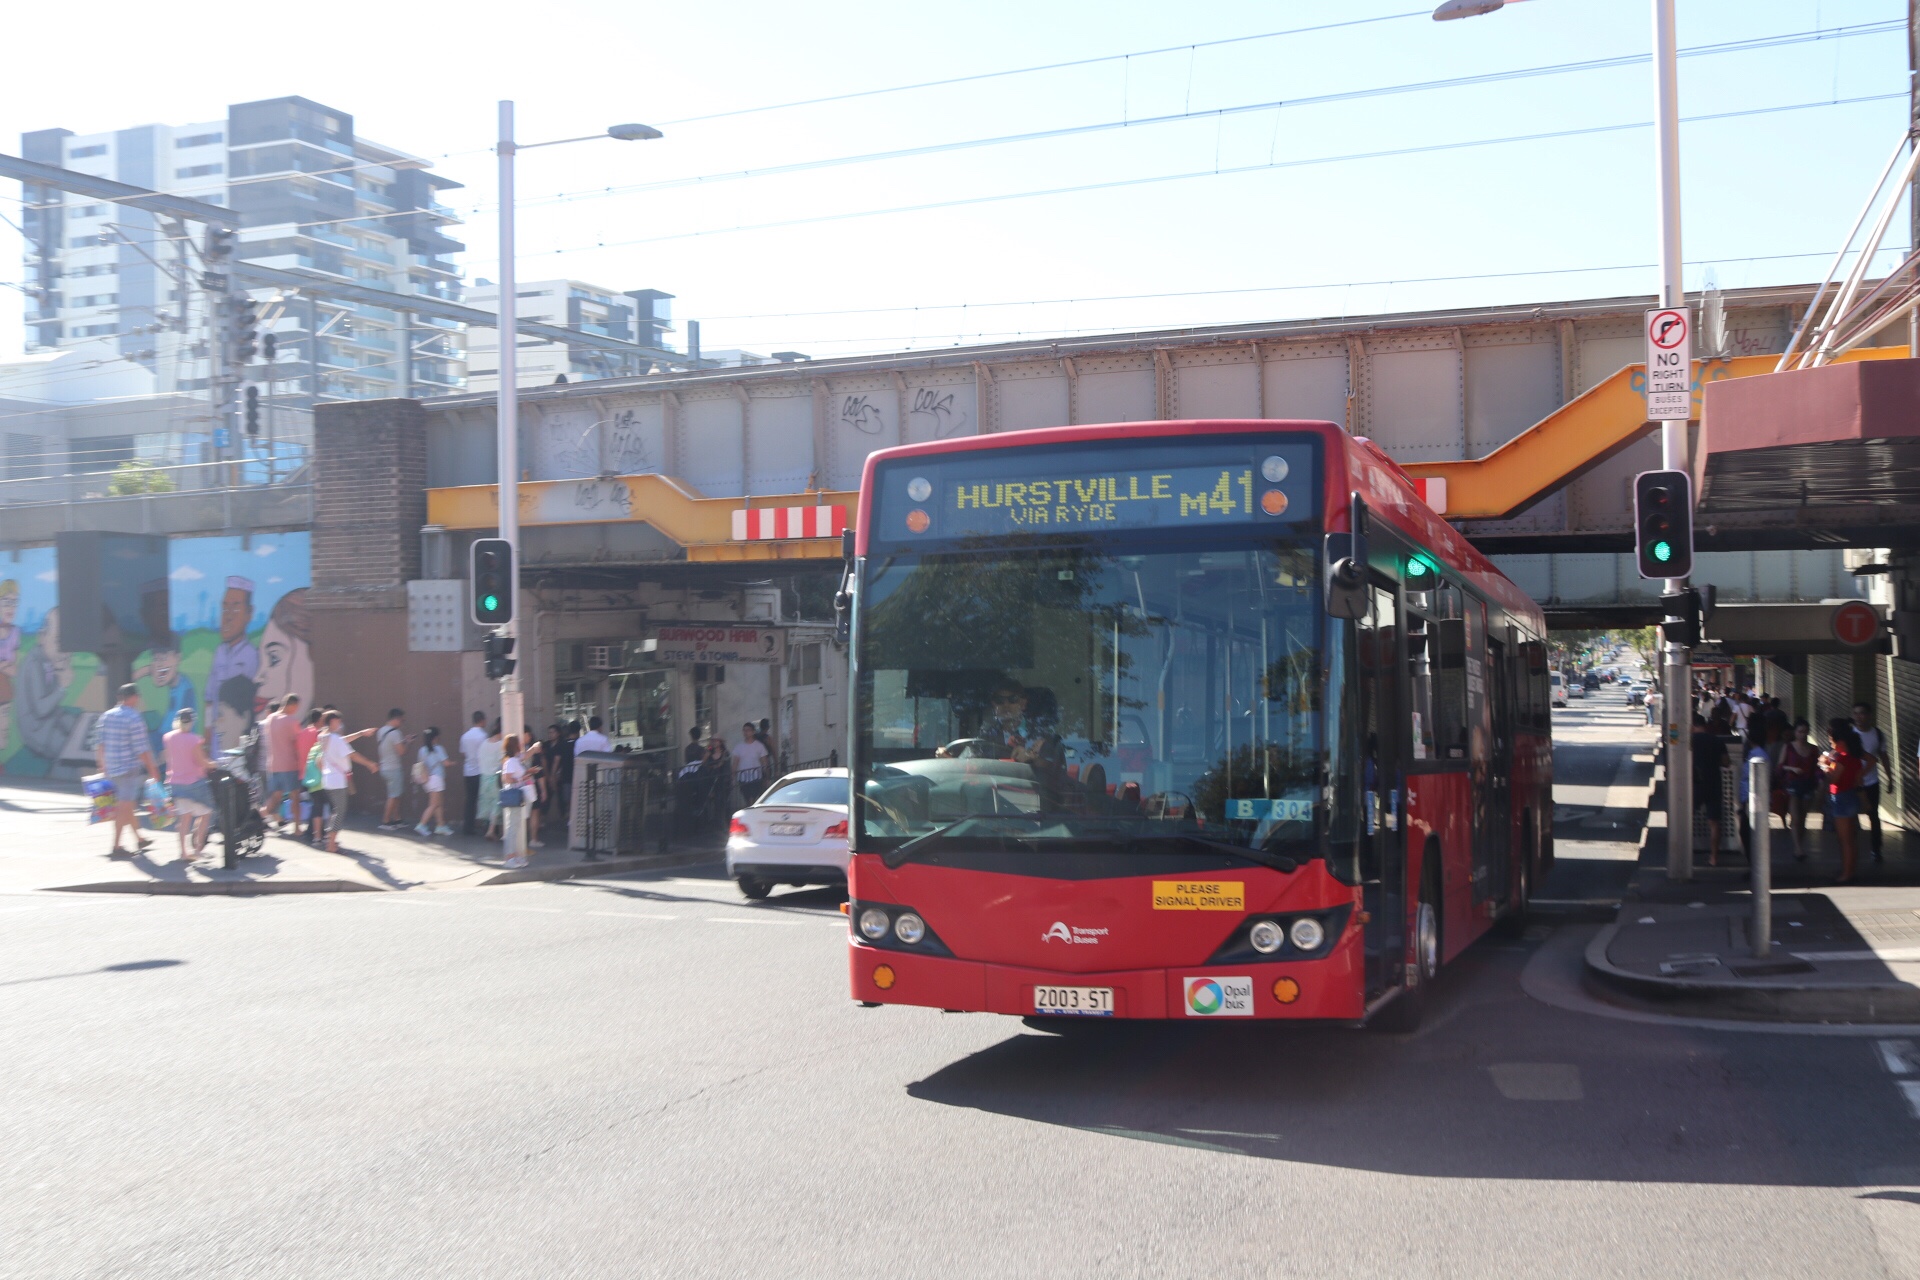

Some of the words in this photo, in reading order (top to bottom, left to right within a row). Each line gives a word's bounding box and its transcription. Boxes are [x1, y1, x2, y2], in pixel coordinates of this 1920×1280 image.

[1657, 352, 1680, 366] NO
[1652, 369, 1685, 380] RIGHT
[1654, 382, 1684, 391] TURN
[1655, 395, 1682, 404] BUSES
[1649, 406, 1688, 415] EXCEPTED
[957, 474, 1173, 509] HURSTVILLE
[1180, 470, 1253, 517] M41
[1010, 506, 1049, 525] VIA
[1056, 503, 1117, 523] RYDE
[1846, 614, 1864, 637] T
[660, 628, 725, 641] BURWOOD
[729, 629, 758, 643] HAIR
[696, 642, 709, 651] BY
[664, 650, 695, 661] STEVE
[1237, 800, 1254, 817] B
[1276, 800, 1311, 819] 304
[1176, 884, 1220, 894] PLEASE
[1155, 896, 1197, 906] SIGNAL
[1200, 897, 1242, 907] DRIVER
[1072, 927, 1109, 936] Transport
[1073, 935, 1099, 945] Buses
[1224, 984, 1251, 999] Opal
[1225, 998, 1246, 1009] bus
